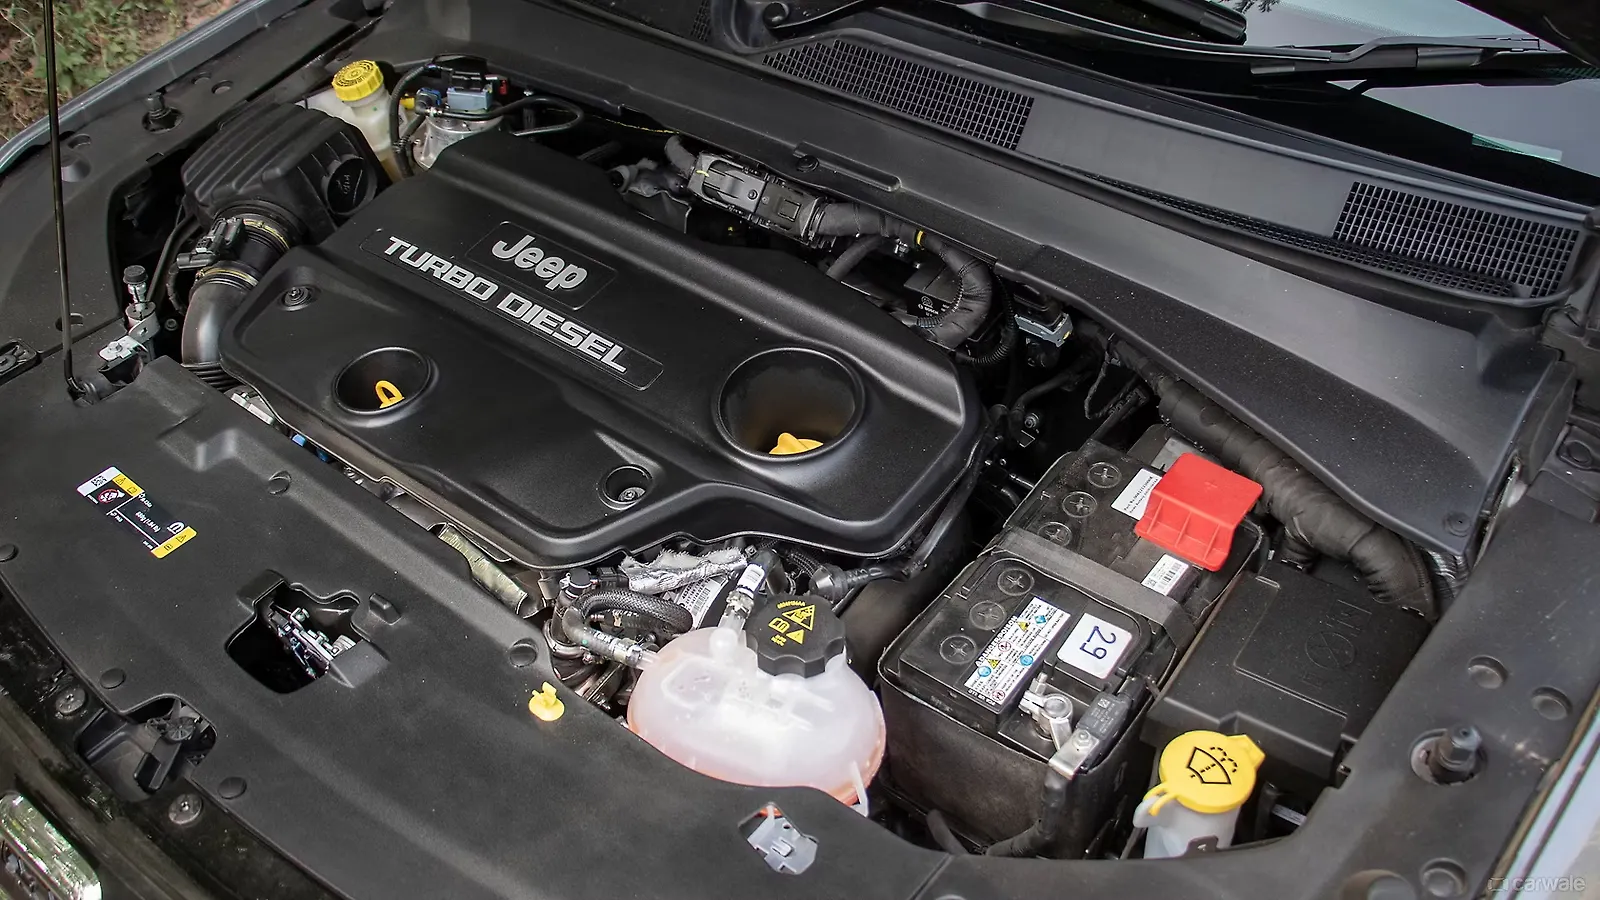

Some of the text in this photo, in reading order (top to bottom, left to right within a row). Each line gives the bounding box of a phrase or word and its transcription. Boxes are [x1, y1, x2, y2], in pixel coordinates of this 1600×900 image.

[491, 234, 588, 291] Jeep
[384, 236, 627, 373] TURBO DIESEL
[1080, 625, 1117, 659] 29
